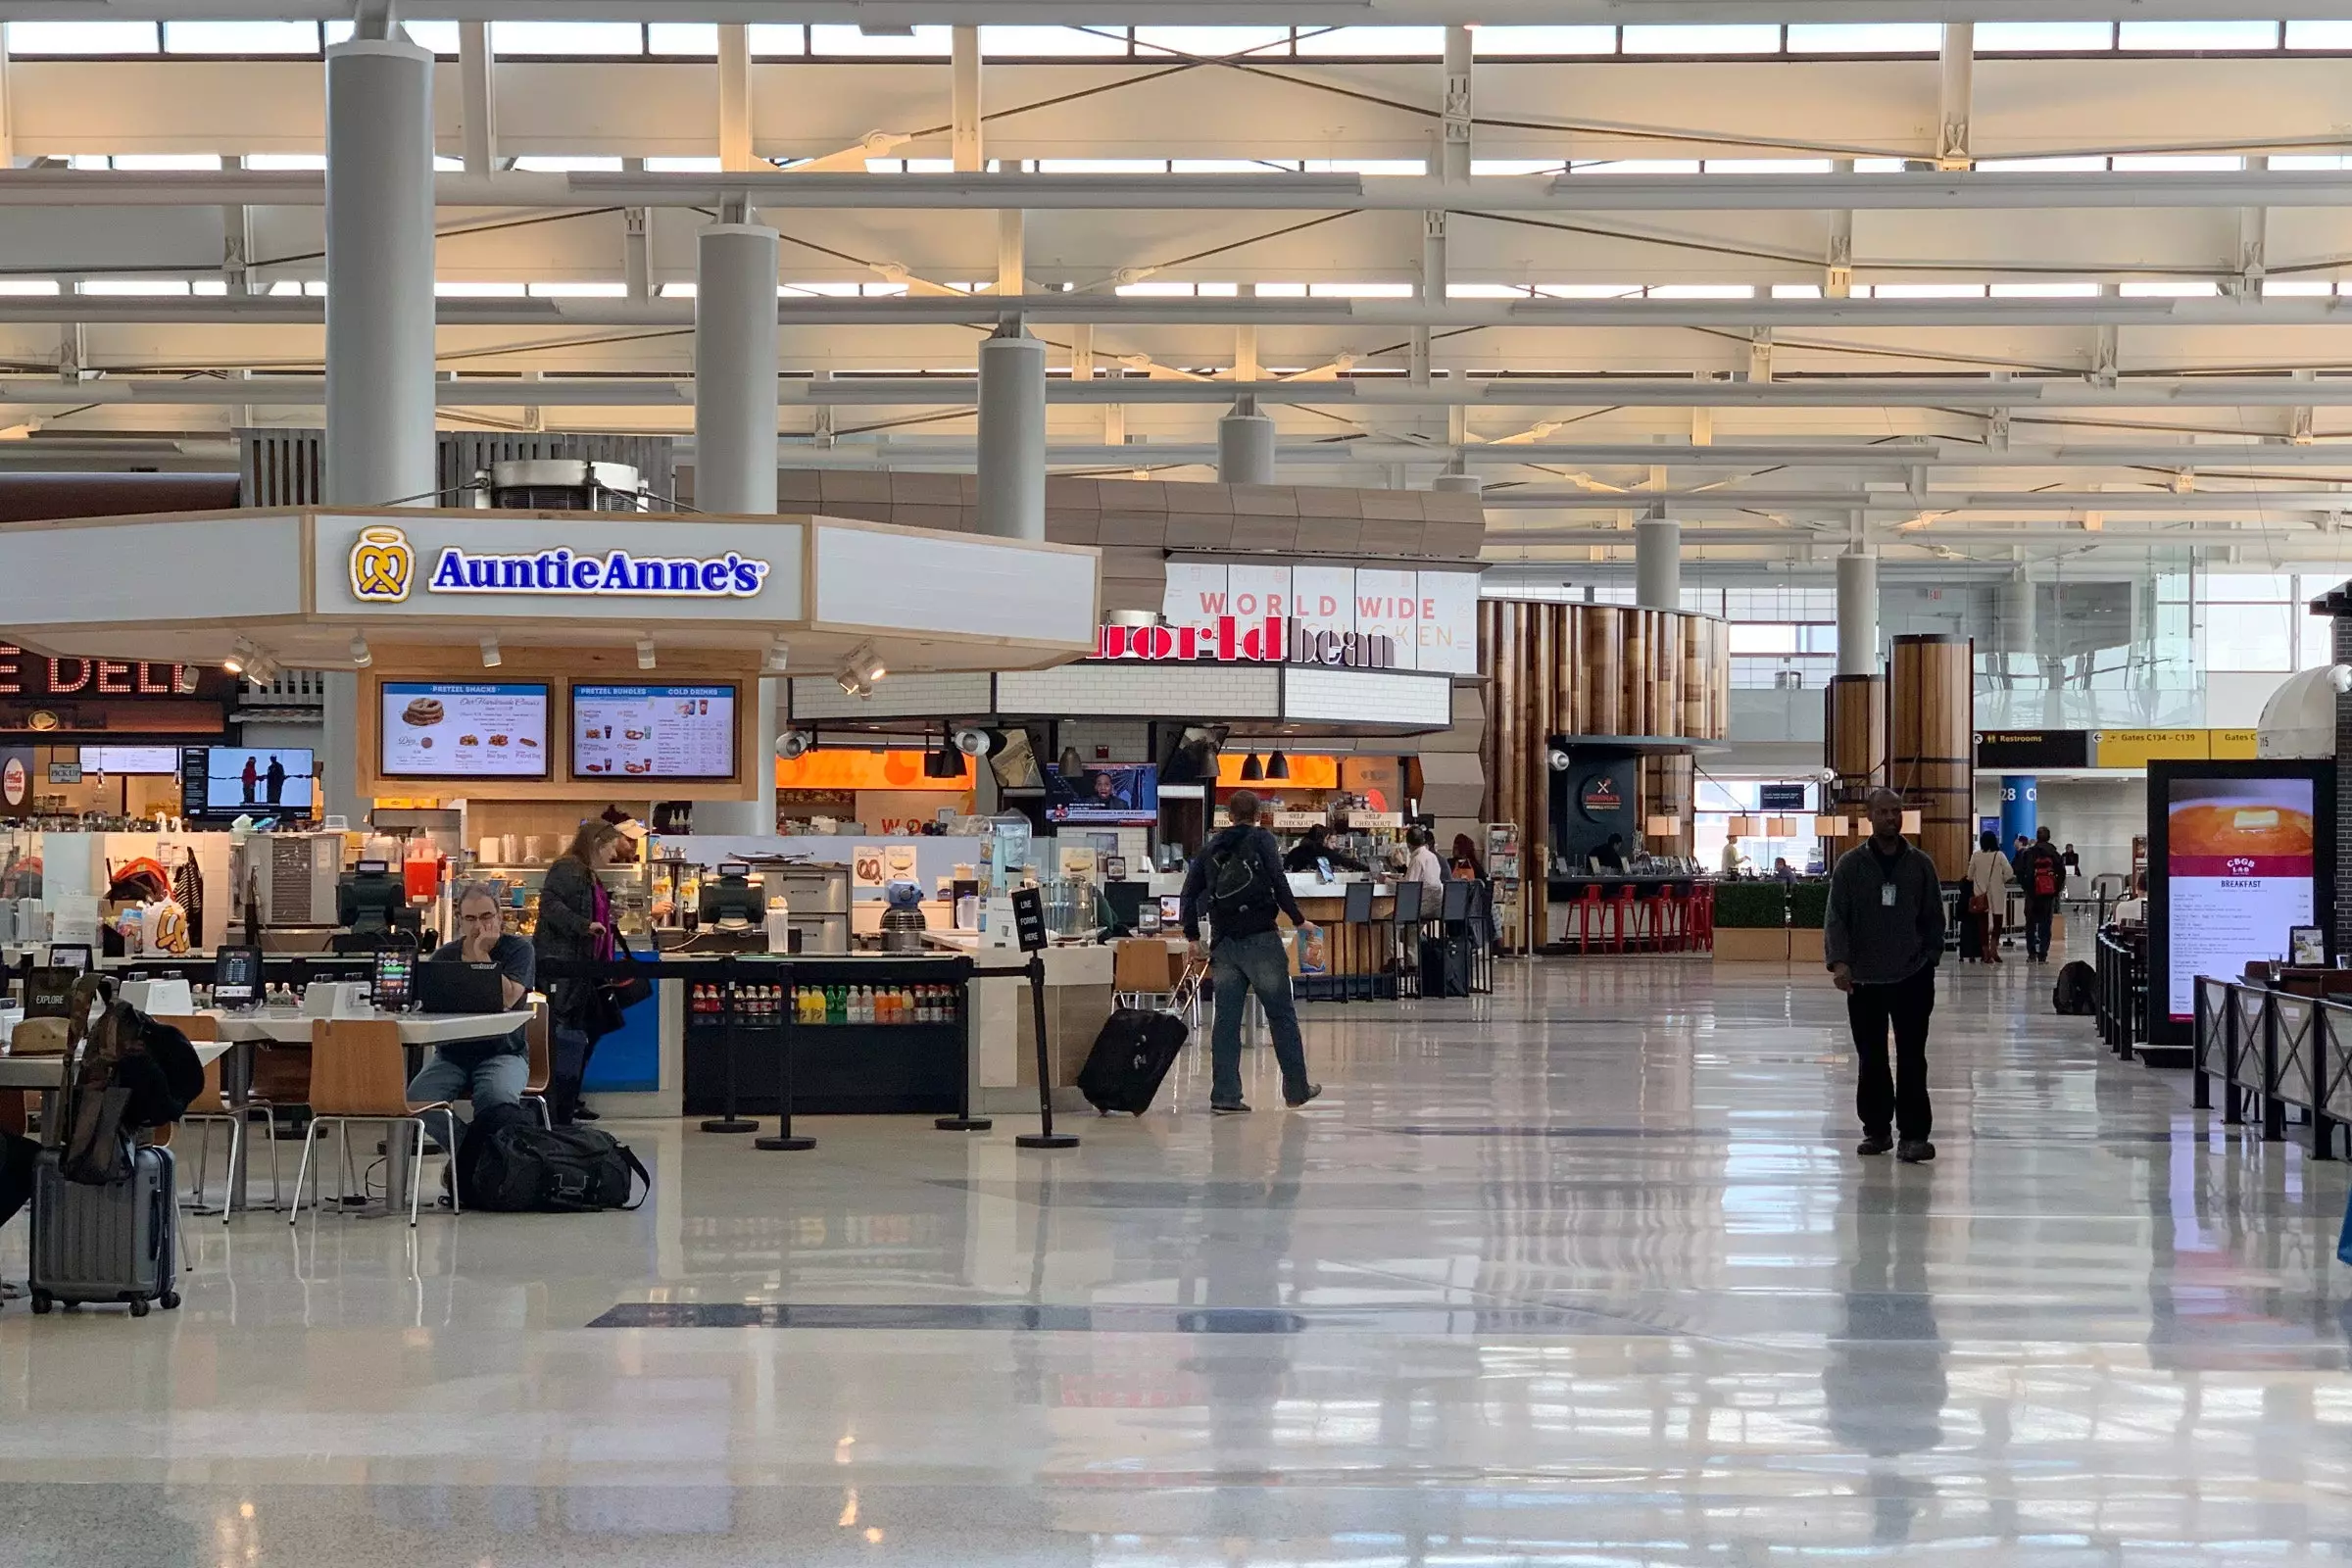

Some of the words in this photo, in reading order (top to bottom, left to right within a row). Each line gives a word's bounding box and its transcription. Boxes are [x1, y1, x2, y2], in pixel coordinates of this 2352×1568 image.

[1200, 592, 1337, 616] WORLD
[1357, 596, 1435, 620] WIDE
[1289, 616, 1396, 668] bean
[2000, 734, 2041, 743] Restrooms
[2121, 733, 2144, 743] Gates
[2146, 733, 2167, 742] C134
[2175, 733, 2195, 742] C139
[35, 995, 64, 1004] EXPLORE
